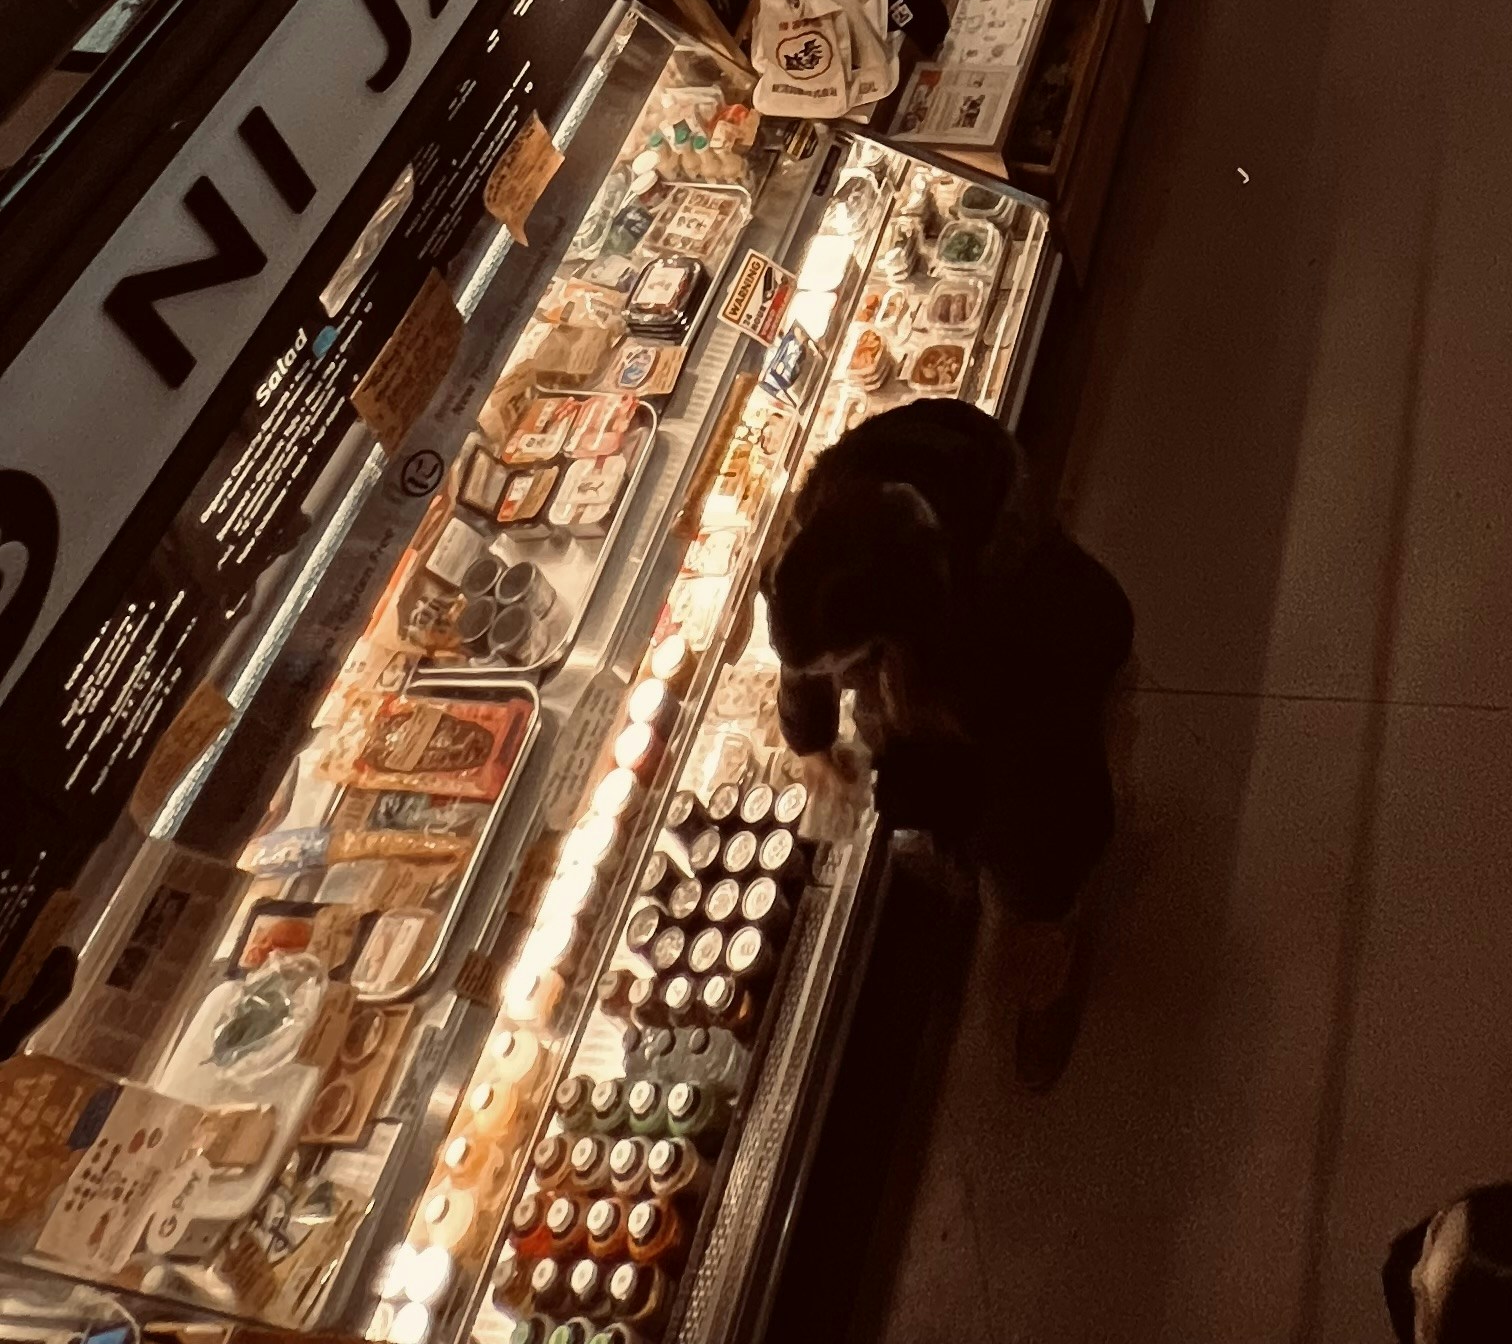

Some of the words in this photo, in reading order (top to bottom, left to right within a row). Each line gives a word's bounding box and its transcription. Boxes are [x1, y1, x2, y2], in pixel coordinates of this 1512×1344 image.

[102, 105, 318, 390] NI
[729, 260, 761, 316] WARNING
[254, 326, 309, 408] Salad
